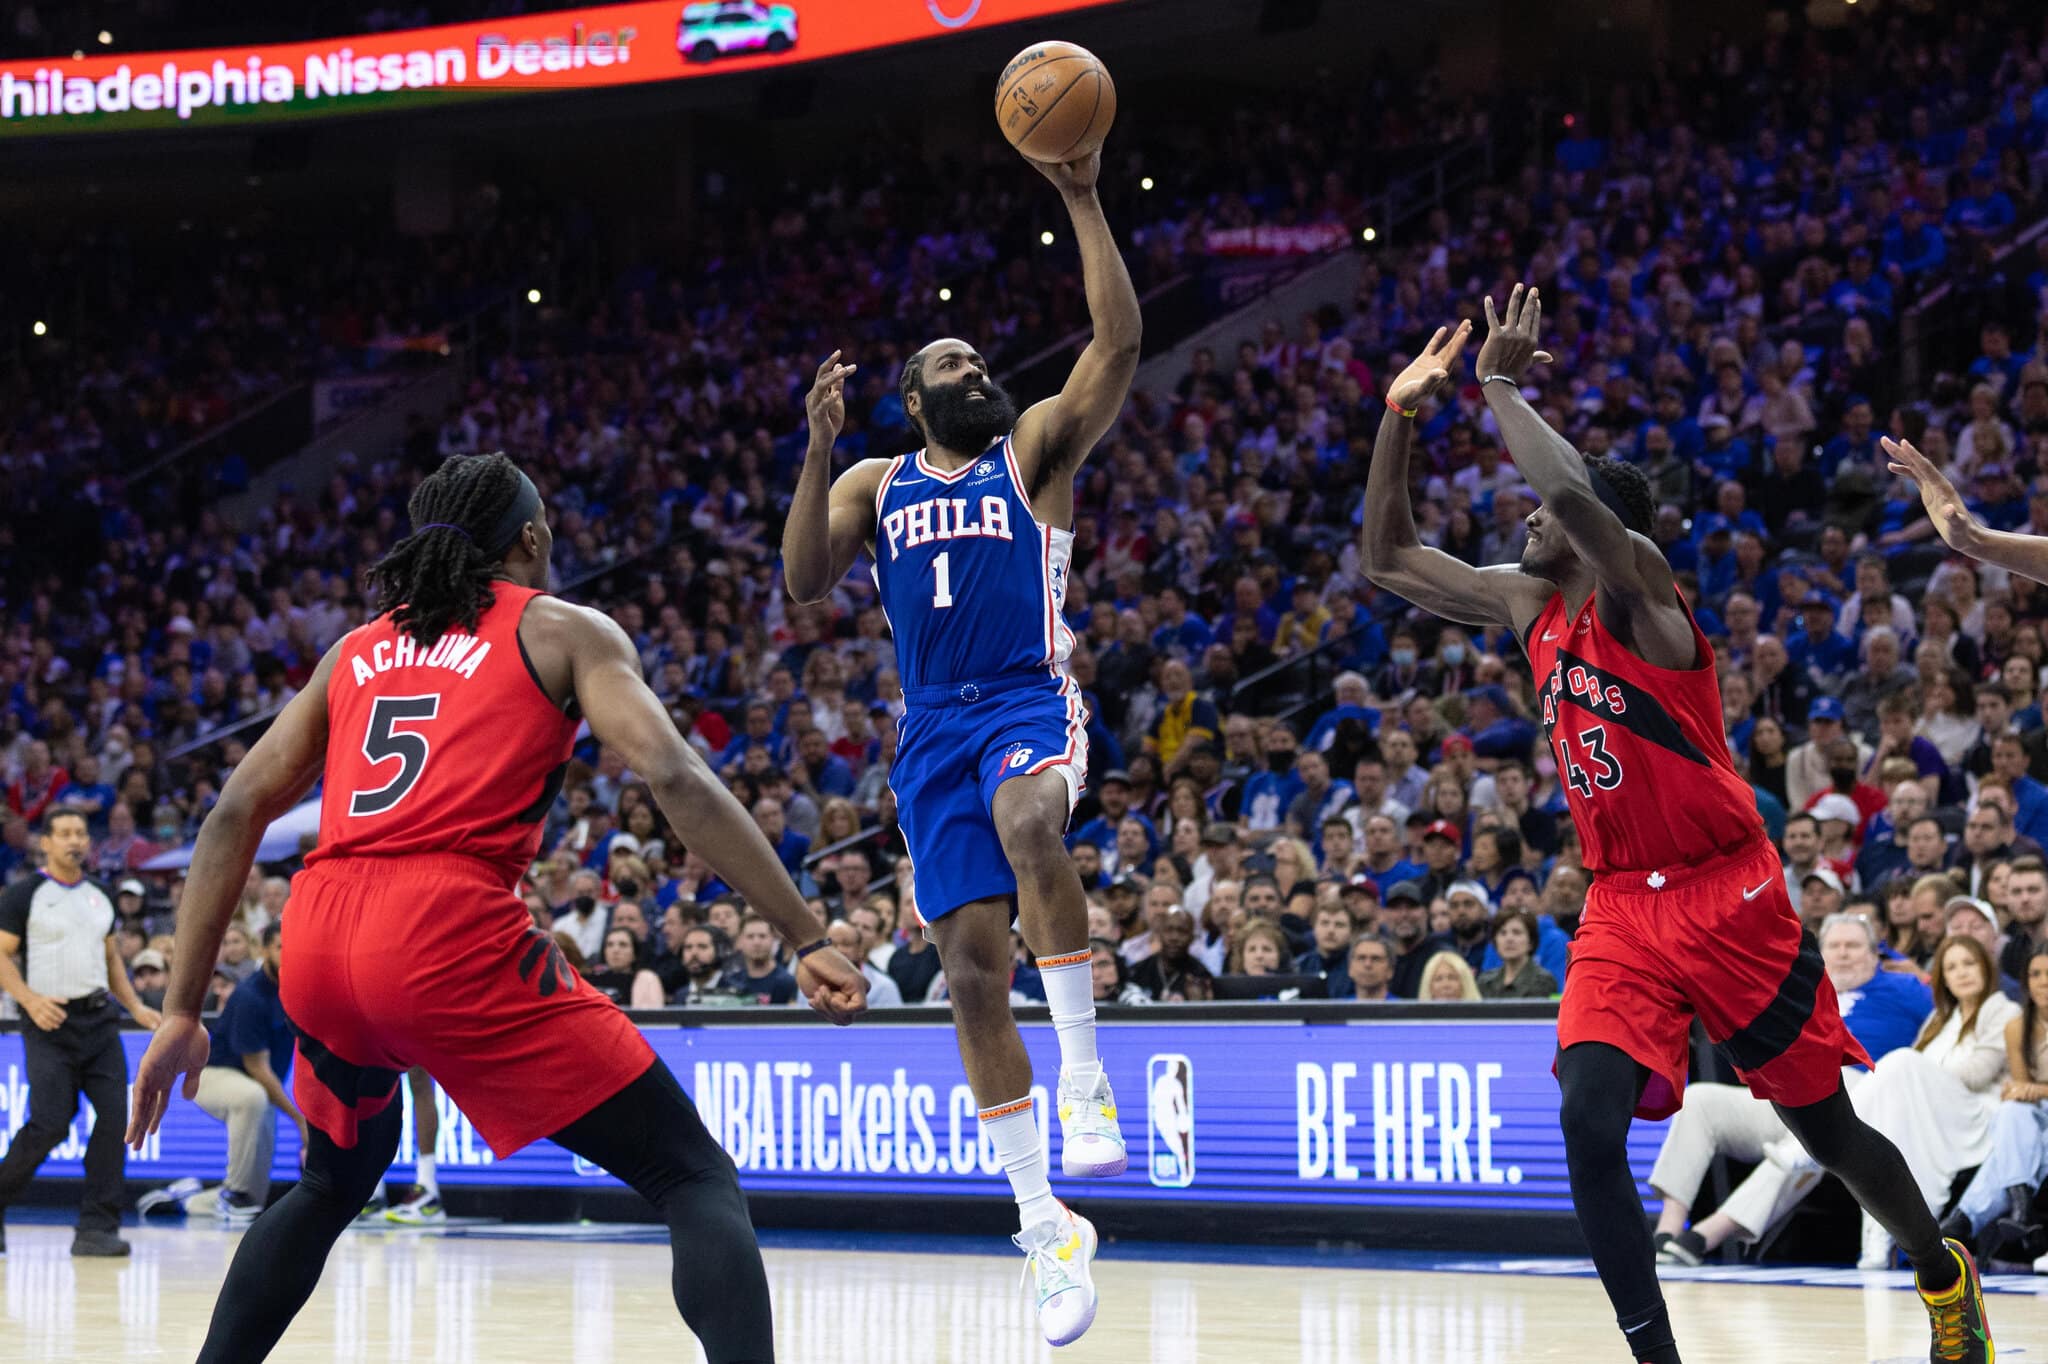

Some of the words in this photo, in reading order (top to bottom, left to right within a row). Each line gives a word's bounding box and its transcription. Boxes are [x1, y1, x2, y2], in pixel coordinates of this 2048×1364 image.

[0, 55, 294, 118] hiladelphia
[304, 48, 467, 99] Nissan
[476, 22, 637, 79] Dealer
[967, 472, 1005, 488] crypto.com
[883, 495, 1013, 562] PHILA
[932, 551, 953, 608] 1
[1543, 660, 1626, 742] APTORS
[348, 692, 441, 816] 5
[1560, 725, 1623, 798] 43
[1296, 1062, 1359, 1180] BE
[1372, 1062, 1523, 1185] HERE.
